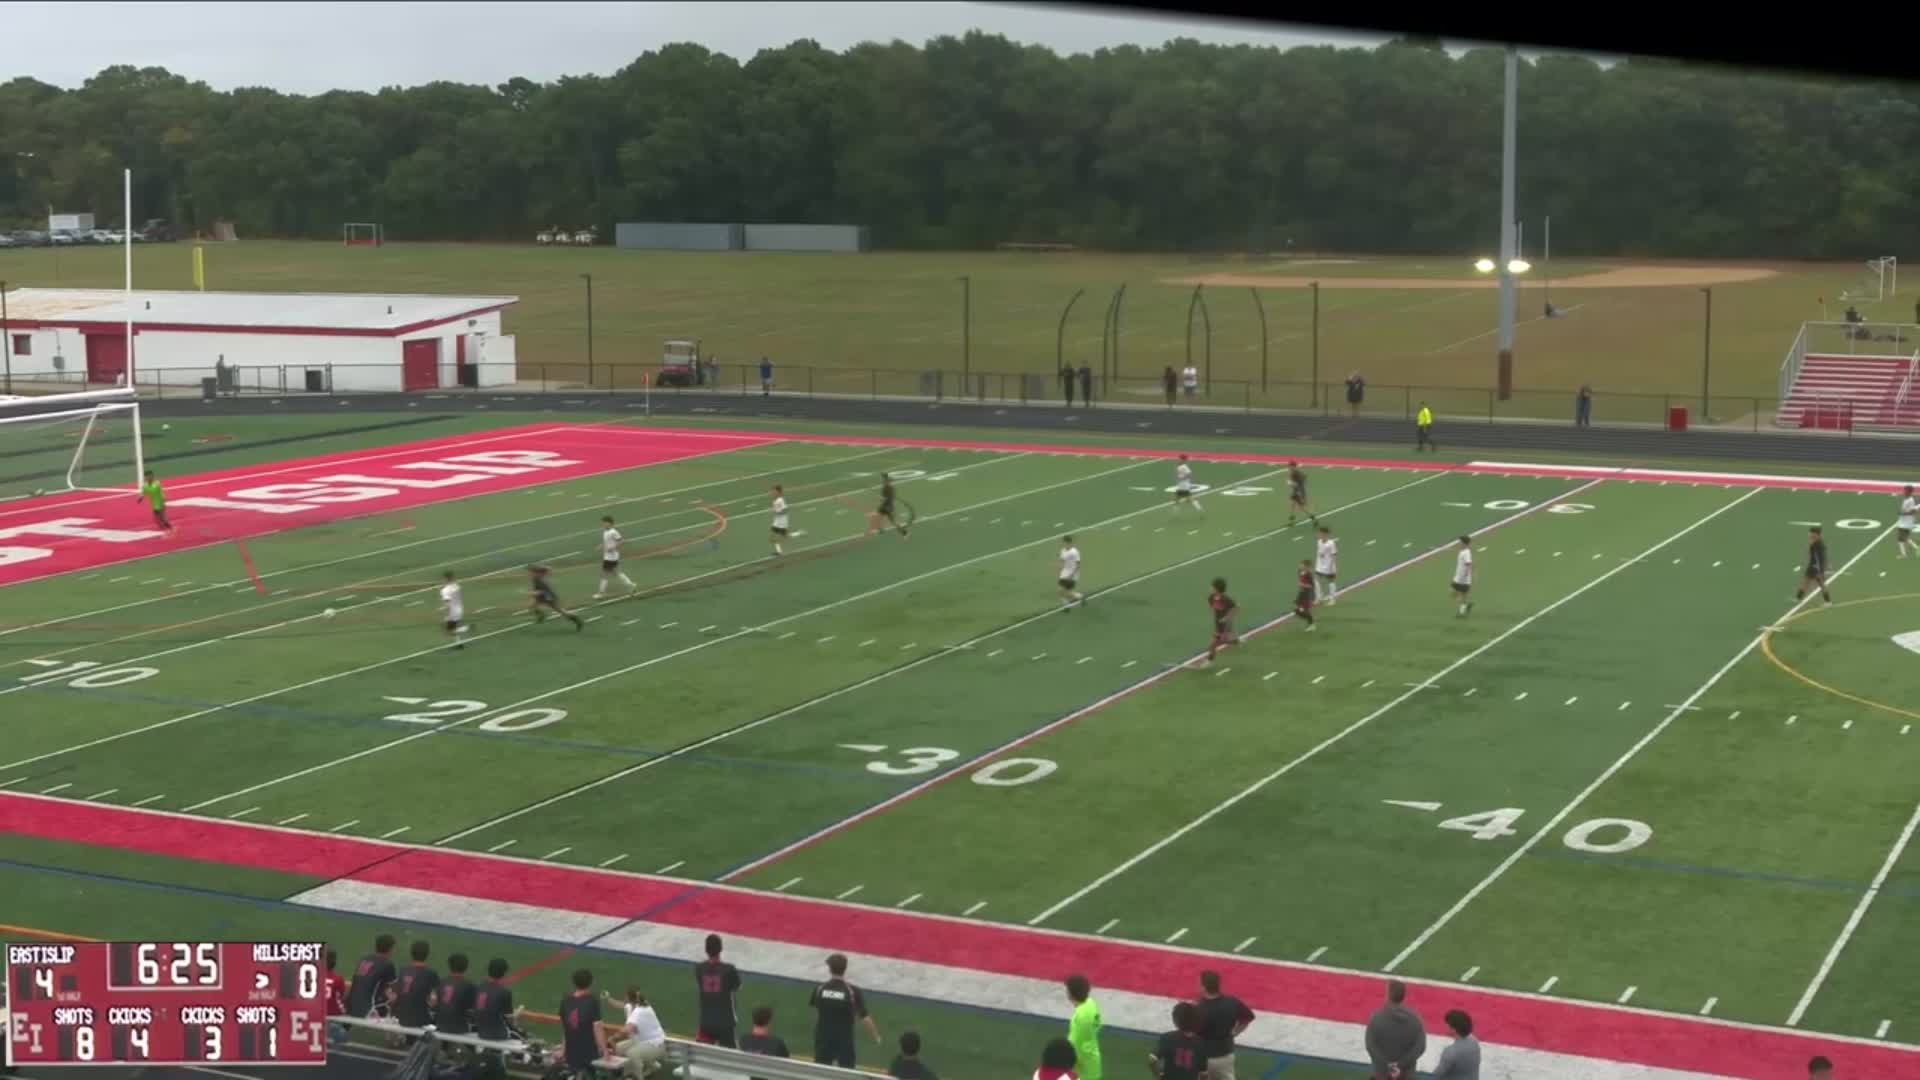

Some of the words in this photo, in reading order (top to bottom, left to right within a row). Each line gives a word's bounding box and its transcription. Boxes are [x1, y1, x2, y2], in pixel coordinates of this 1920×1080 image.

[19, 660, 160, 689] 10
[384, 699, 568, 732] 20
[866, 746, 1057, 788] 30
[1437, 807, 1653, 854] 40
